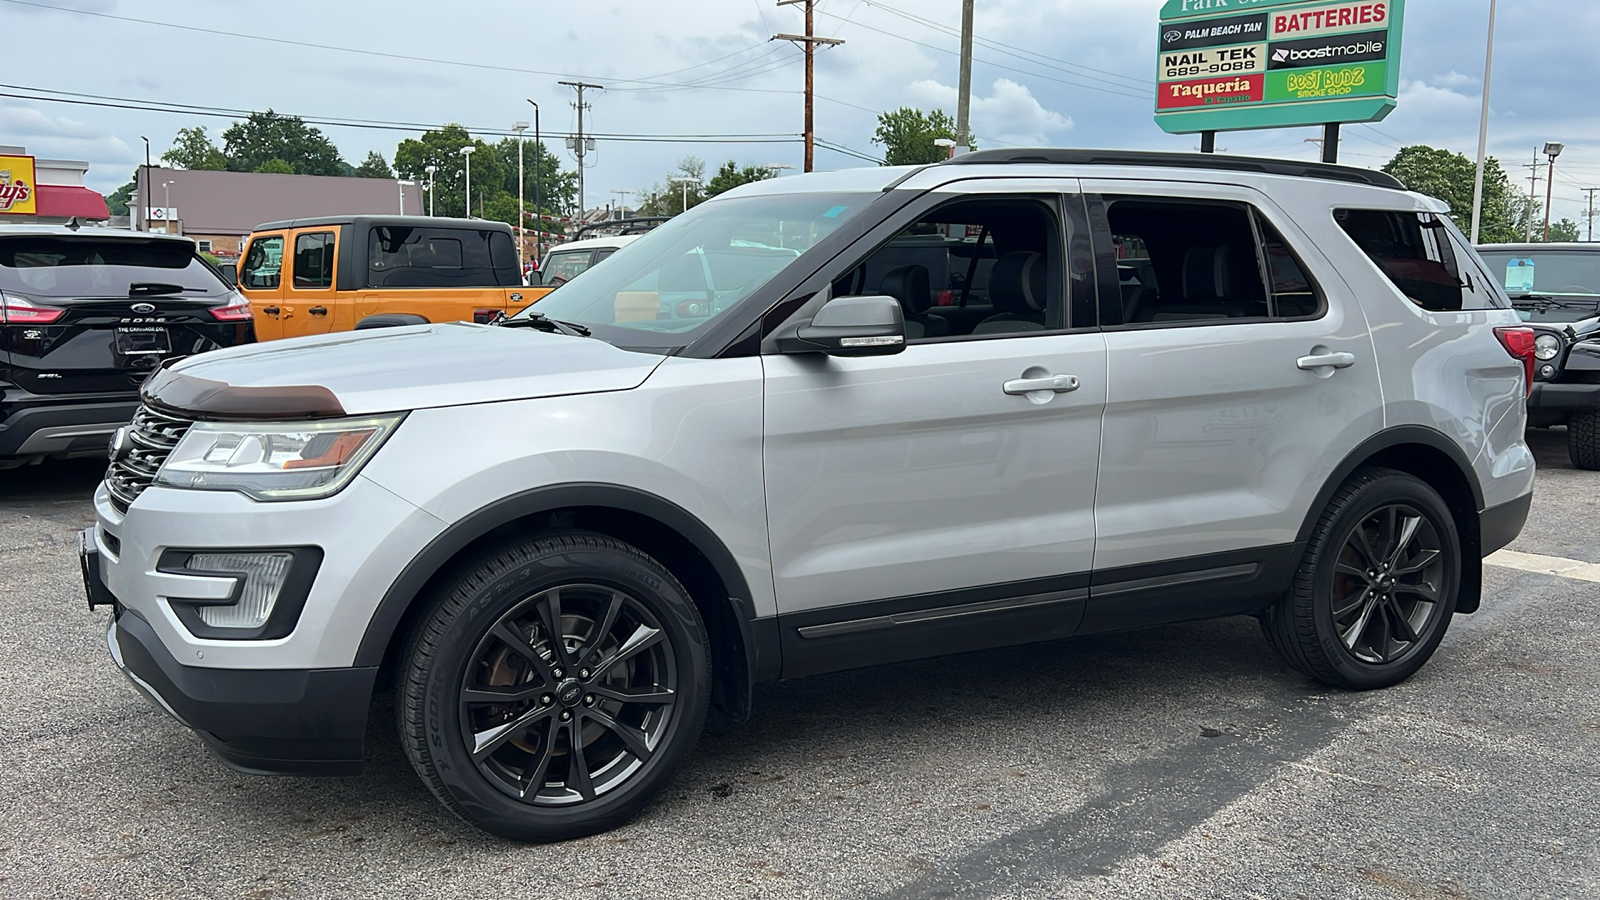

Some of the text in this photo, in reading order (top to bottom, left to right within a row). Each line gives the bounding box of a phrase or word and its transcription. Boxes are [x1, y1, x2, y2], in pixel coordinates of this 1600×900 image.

[1274, 3, 1386, 34] BATTERIES
[1184, 22, 1263, 40] PALM BEACH TAN
[1165, 47, 1257, 67] NAIL TEK
[1166, 60, 1255, 77] 689-9088
[1327, 86, 1352, 96] SHOP
[519, 568, 531, 581] 3
